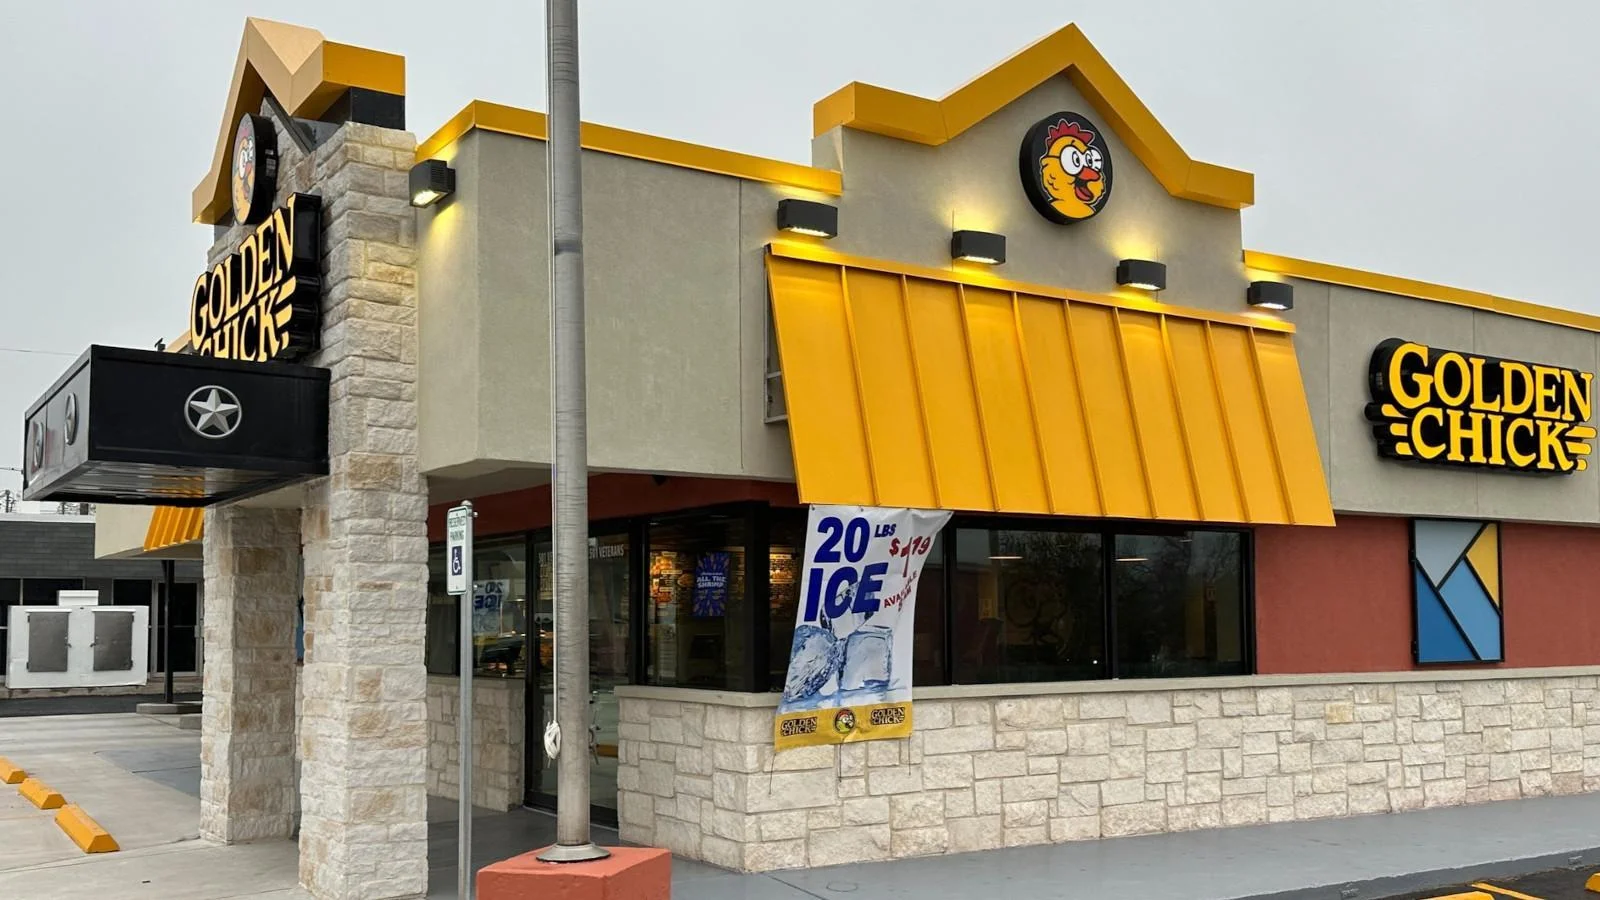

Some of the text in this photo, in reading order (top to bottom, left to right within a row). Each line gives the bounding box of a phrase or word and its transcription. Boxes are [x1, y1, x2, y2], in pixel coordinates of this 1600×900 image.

[191, 192, 296, 350] GOLDEN
[201, 286, 280, 362] HICK
[1389, 342, 1594, 422] GOLDEN
[1411, 407, 1574, 471] CHICK
[813, 516, 897, 563] 20 LBS
[803, 562, 889, 622] ICE
[781, 716, 817, 730] GOLDEN
[782, 725, 814, 736] CHICK
[871, 707, 905, 720] GOLDEN
[872, 716, 902, 725] CHICK
